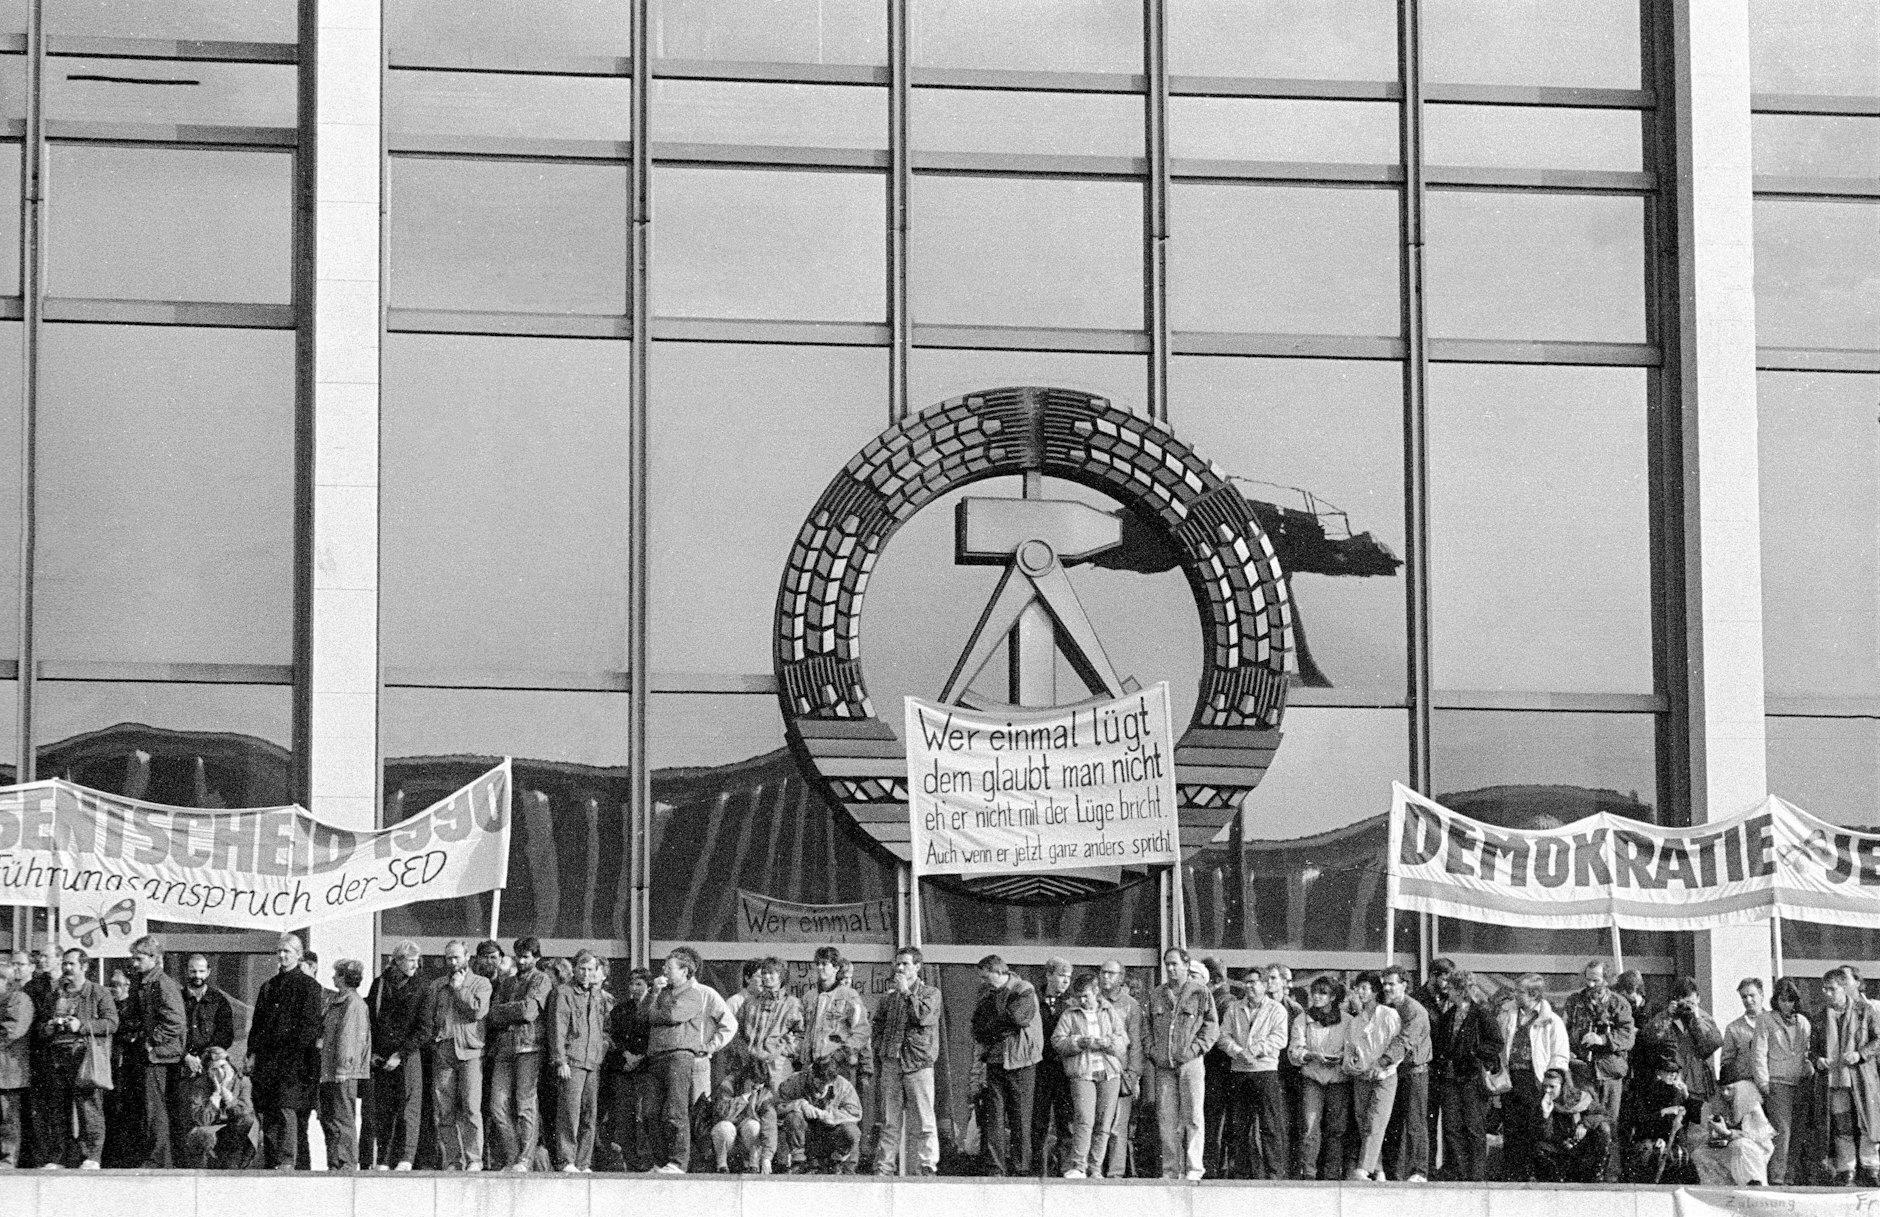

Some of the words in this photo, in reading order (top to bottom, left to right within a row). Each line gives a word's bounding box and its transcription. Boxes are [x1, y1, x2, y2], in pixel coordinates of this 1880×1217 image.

[918, 708, 980, 751] Wer
[990, 711, 1078, 751] einmal
[1093, 697, 1150, 752] lügt
[924, 758, 972, 794] dem
[983, 753, 1051, 802] glaubt
[1063, 762, 1104, 788] man
[1112, 742, 1163, 784] nicht
[952, 811, 968, 830] er
[976, 801, 1015, 828] nicht
[1045, 797, 1069, 825] der
[1075, 794, 1114, 831] Lüge
[1119, 785, 1168, 820] bricht.
[926, 839, 957, 865] Auch
[962, 849, 992, 863] wenn
[997, 848, 1010, 862] er
[1012, 834, 1042, 867] jetzt
[1049, 843, 1078, 864] ganz
[1084, 832, 1125, 858] anders
[1132, 829, 1174, 858] spricht
[1400, 802, 1777, 889] DEMOKRATIE
[326, 873, 378, 906] der
[379, 850, 447, 892] SED
[742, 898, 790, 933] Wer
[799, 902, 871, 933] einmal
